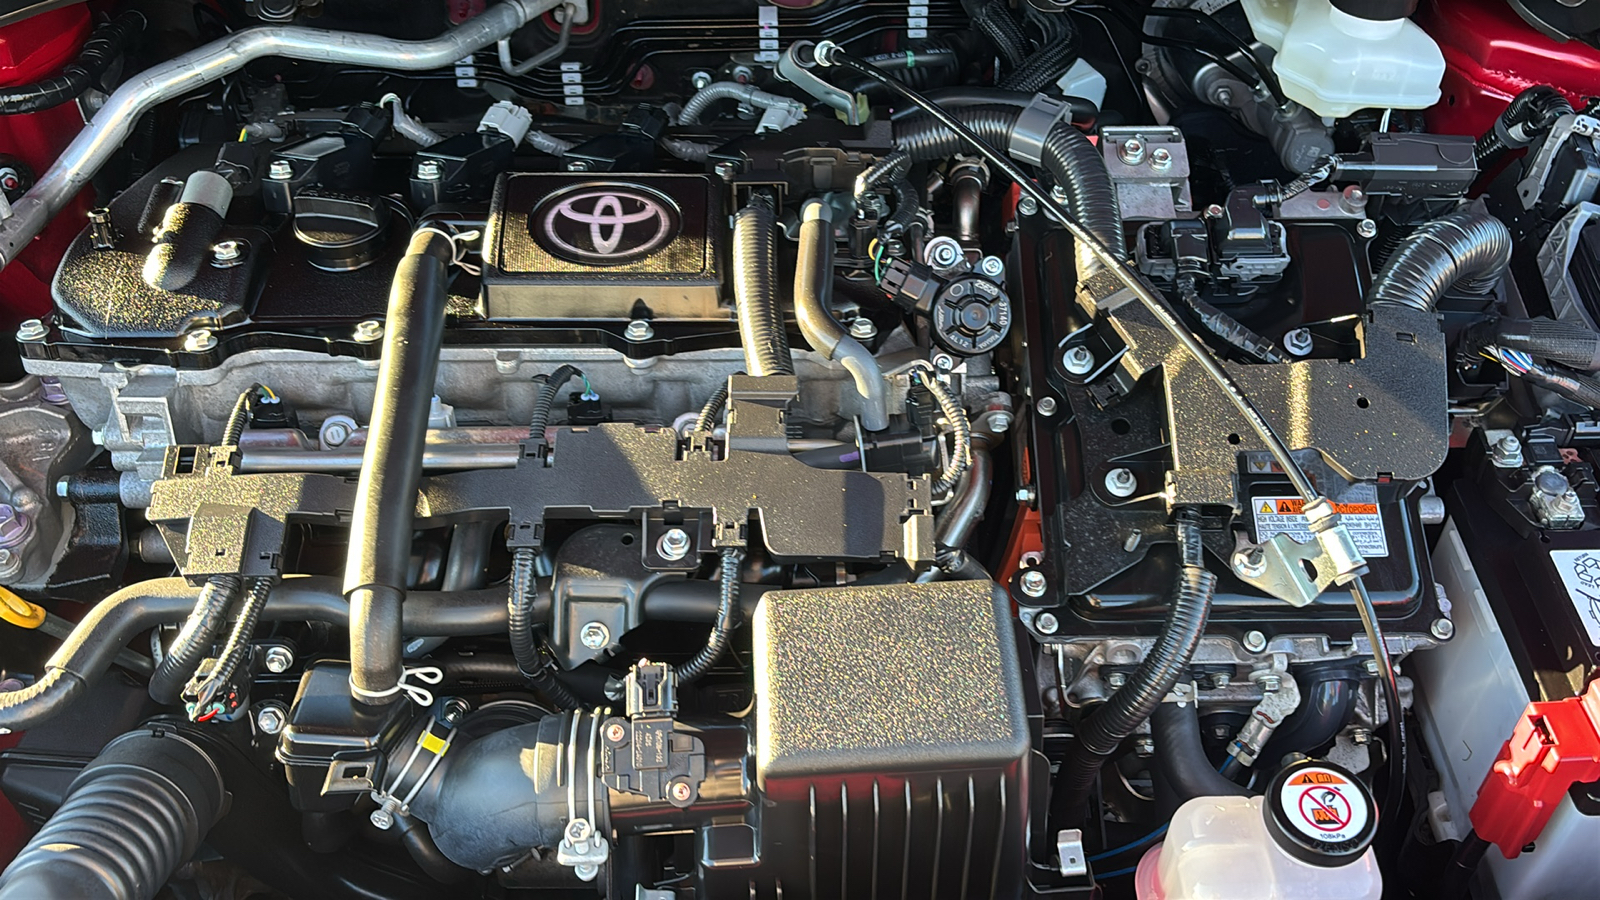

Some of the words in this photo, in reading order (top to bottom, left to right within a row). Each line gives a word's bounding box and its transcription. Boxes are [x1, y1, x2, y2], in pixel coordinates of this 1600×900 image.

[975, 280, 999, 296] 25620
[998, 302, 1008, 326] 37140
[978, 334, 1000, 349] TOYOTA
